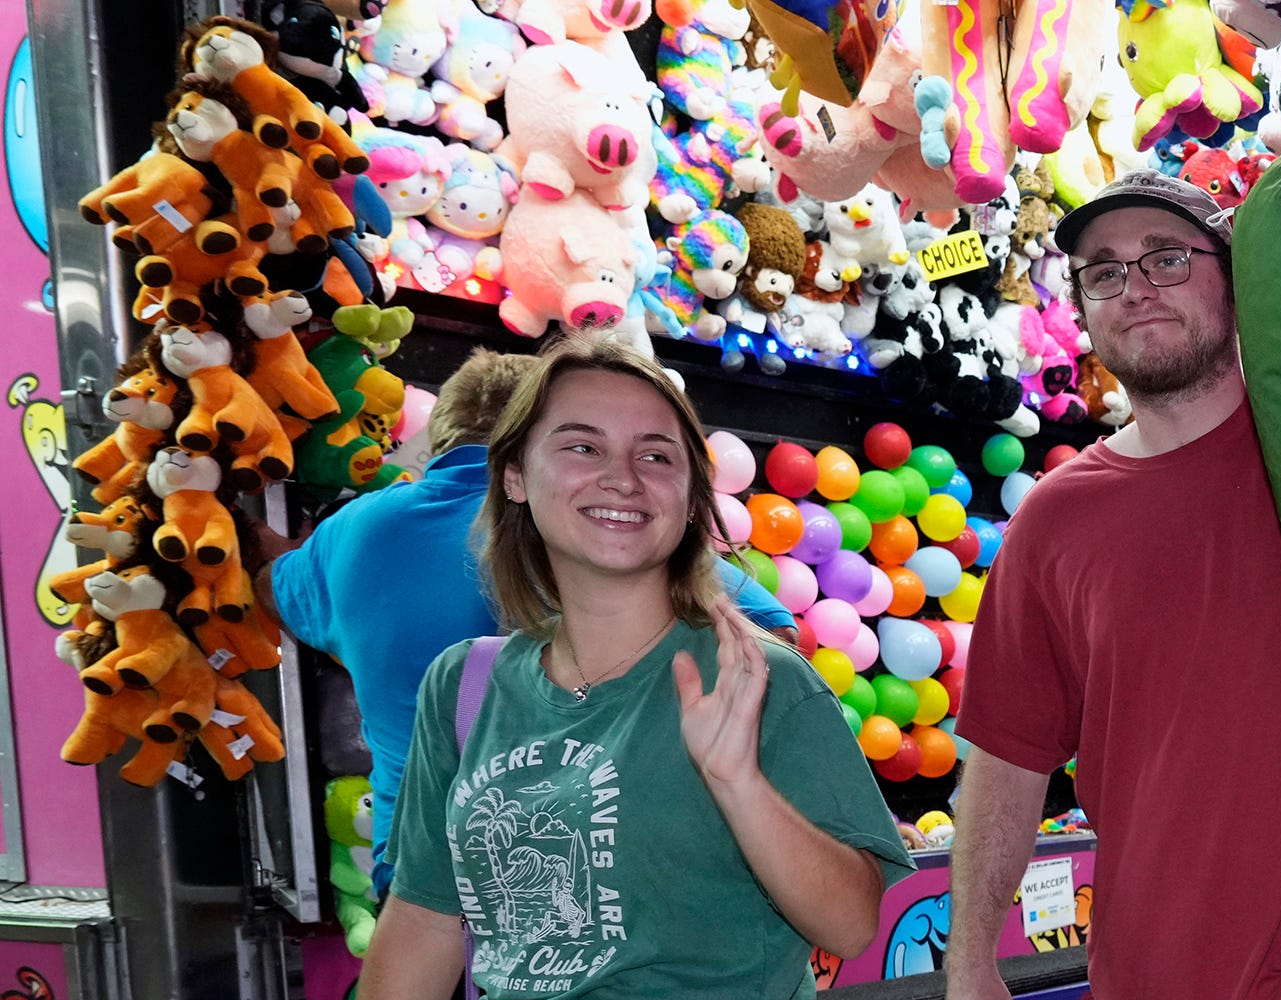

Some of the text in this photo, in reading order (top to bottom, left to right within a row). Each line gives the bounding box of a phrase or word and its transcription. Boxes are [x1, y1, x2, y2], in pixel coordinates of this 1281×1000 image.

[921, 237, 982, 274] CHOICE
[560, 738, 605, 770] THE
[454, 740, 546, 808] WHERE
[588, 759, 621, 869] WAVES
[1024, 875, 1069, 894] WE ACCEPT
[455, 876, 494, 936] FIND
[597, 883, 628, 942] ARE
[528, 945, 589, 976] Club
[533, 978, 573, 992] BEACH
